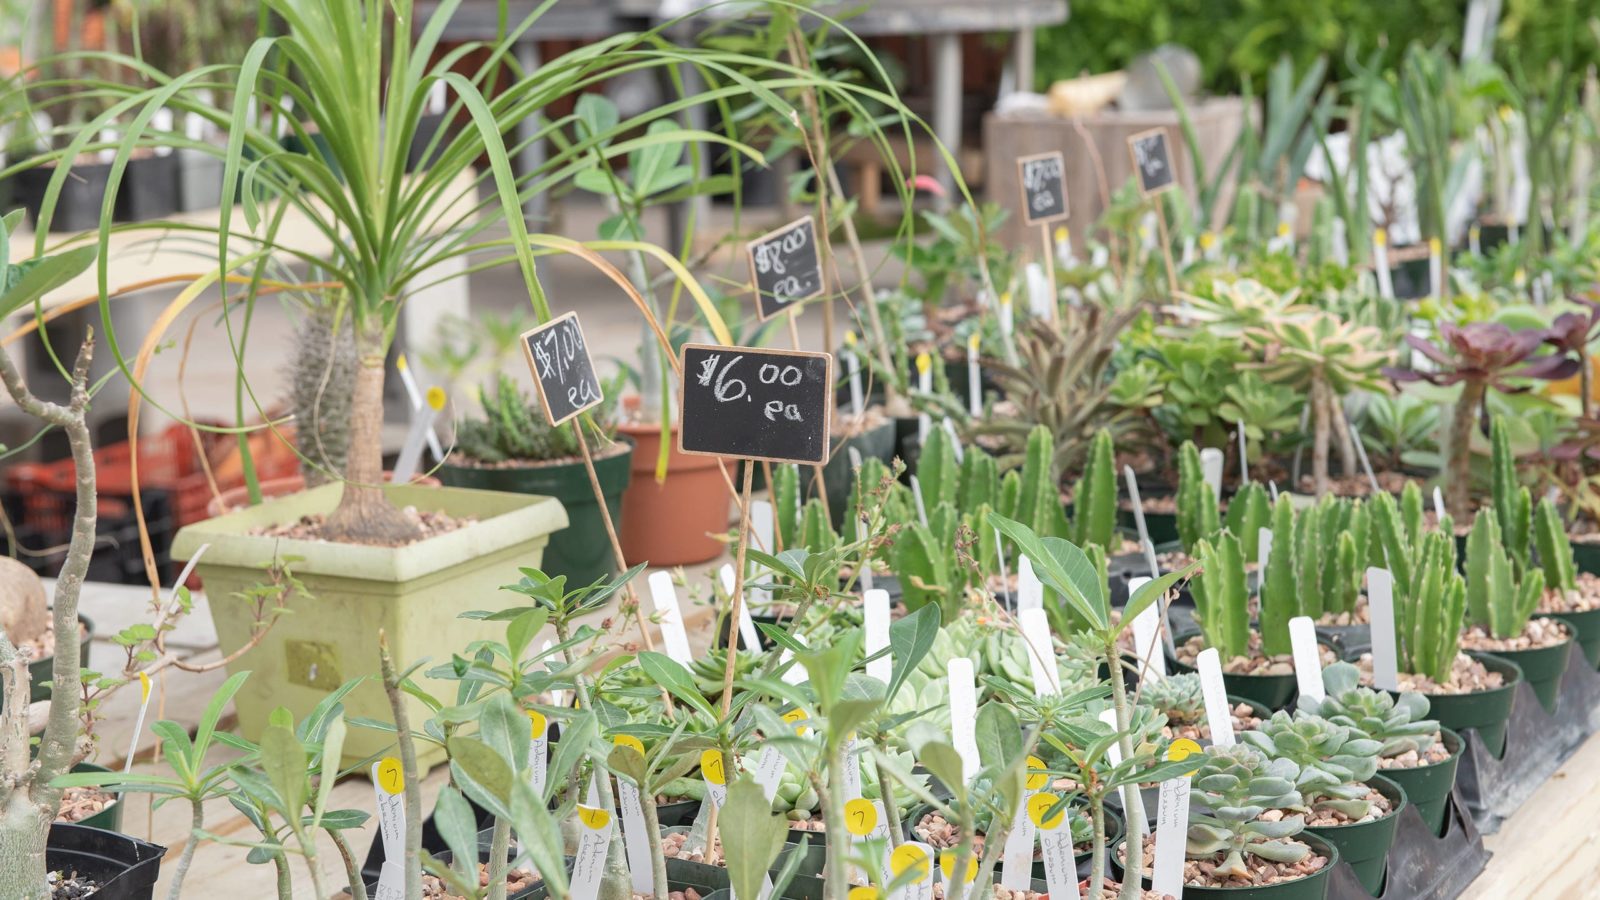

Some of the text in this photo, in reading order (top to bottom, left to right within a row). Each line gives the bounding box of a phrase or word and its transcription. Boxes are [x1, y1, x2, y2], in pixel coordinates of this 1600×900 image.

[568, 378, 601, 409] ea
[764, 400, 804, 422] ea
[386, 768, 398, 788] 7
